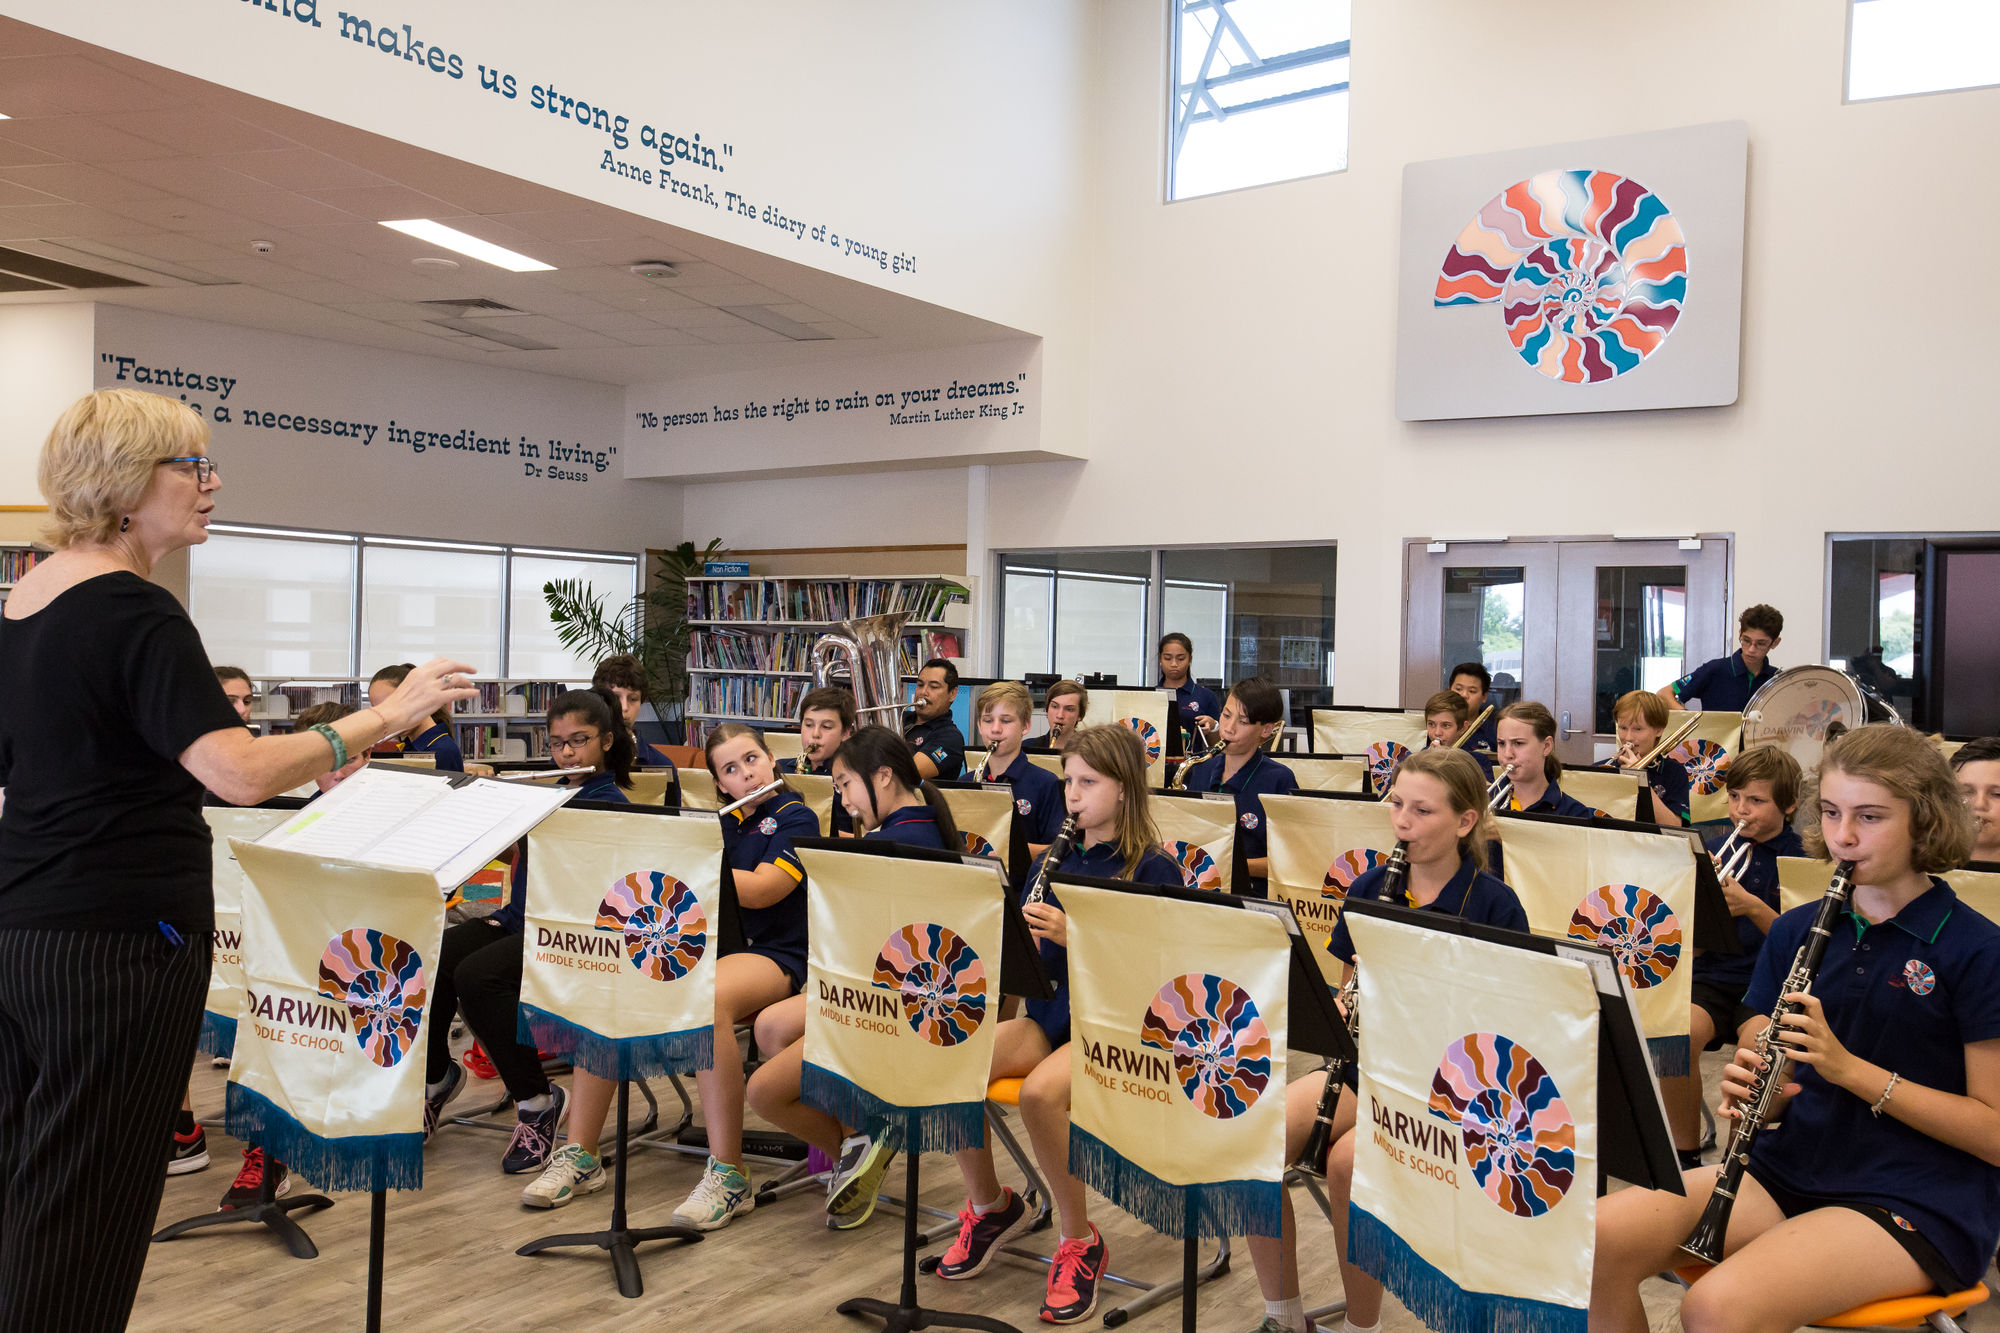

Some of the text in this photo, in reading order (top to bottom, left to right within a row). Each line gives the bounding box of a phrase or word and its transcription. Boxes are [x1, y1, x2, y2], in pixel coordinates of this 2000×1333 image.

[338, 11, 464, 80] makes
[478, 64, 518, 99] us
[530, 84, 630, 150] strong
[640, 124, 733, 173] again."
[600, 150, 917, 274] Anne Frank, The diary of a young girl
[101, 353, 237, 400] "Fantasy
[636, 372, 1026, 432] "No person has the right to rain on your dreams."
[889, 401, 1025, 426] Martin Luther King Jr
[213, 405, 232, 423] a
[243, 409, 378, 446] necessary
[387, 420, 511, 453] ingredient
[519, 436, 540, 458] in
[549, 440, 617, 473] living."
[524, 462, 588, 482] Dr Seuss
[712, 565, 742, 573] Non Fiction
[1763, 726, 1804, 735] DARWIN
[537, 927, 620, 959] DARWIN
[535, 951, 622, 974] MIDDLE SCHOOL
[247, 989, 347, 1034] DARWIN
[819, 979, 898, 1020] DARWIN
[820, 1006, 900, 1037] MIDDLE SCHOOL
[290, 1032, 345, 1054] SCHOOL
[1081, 1033, 1170, 1085] DARWIN
[1122, 1080, 1173, 1105] SCHOOL
[1371, 1095, 1457, 1165] DARWIN
